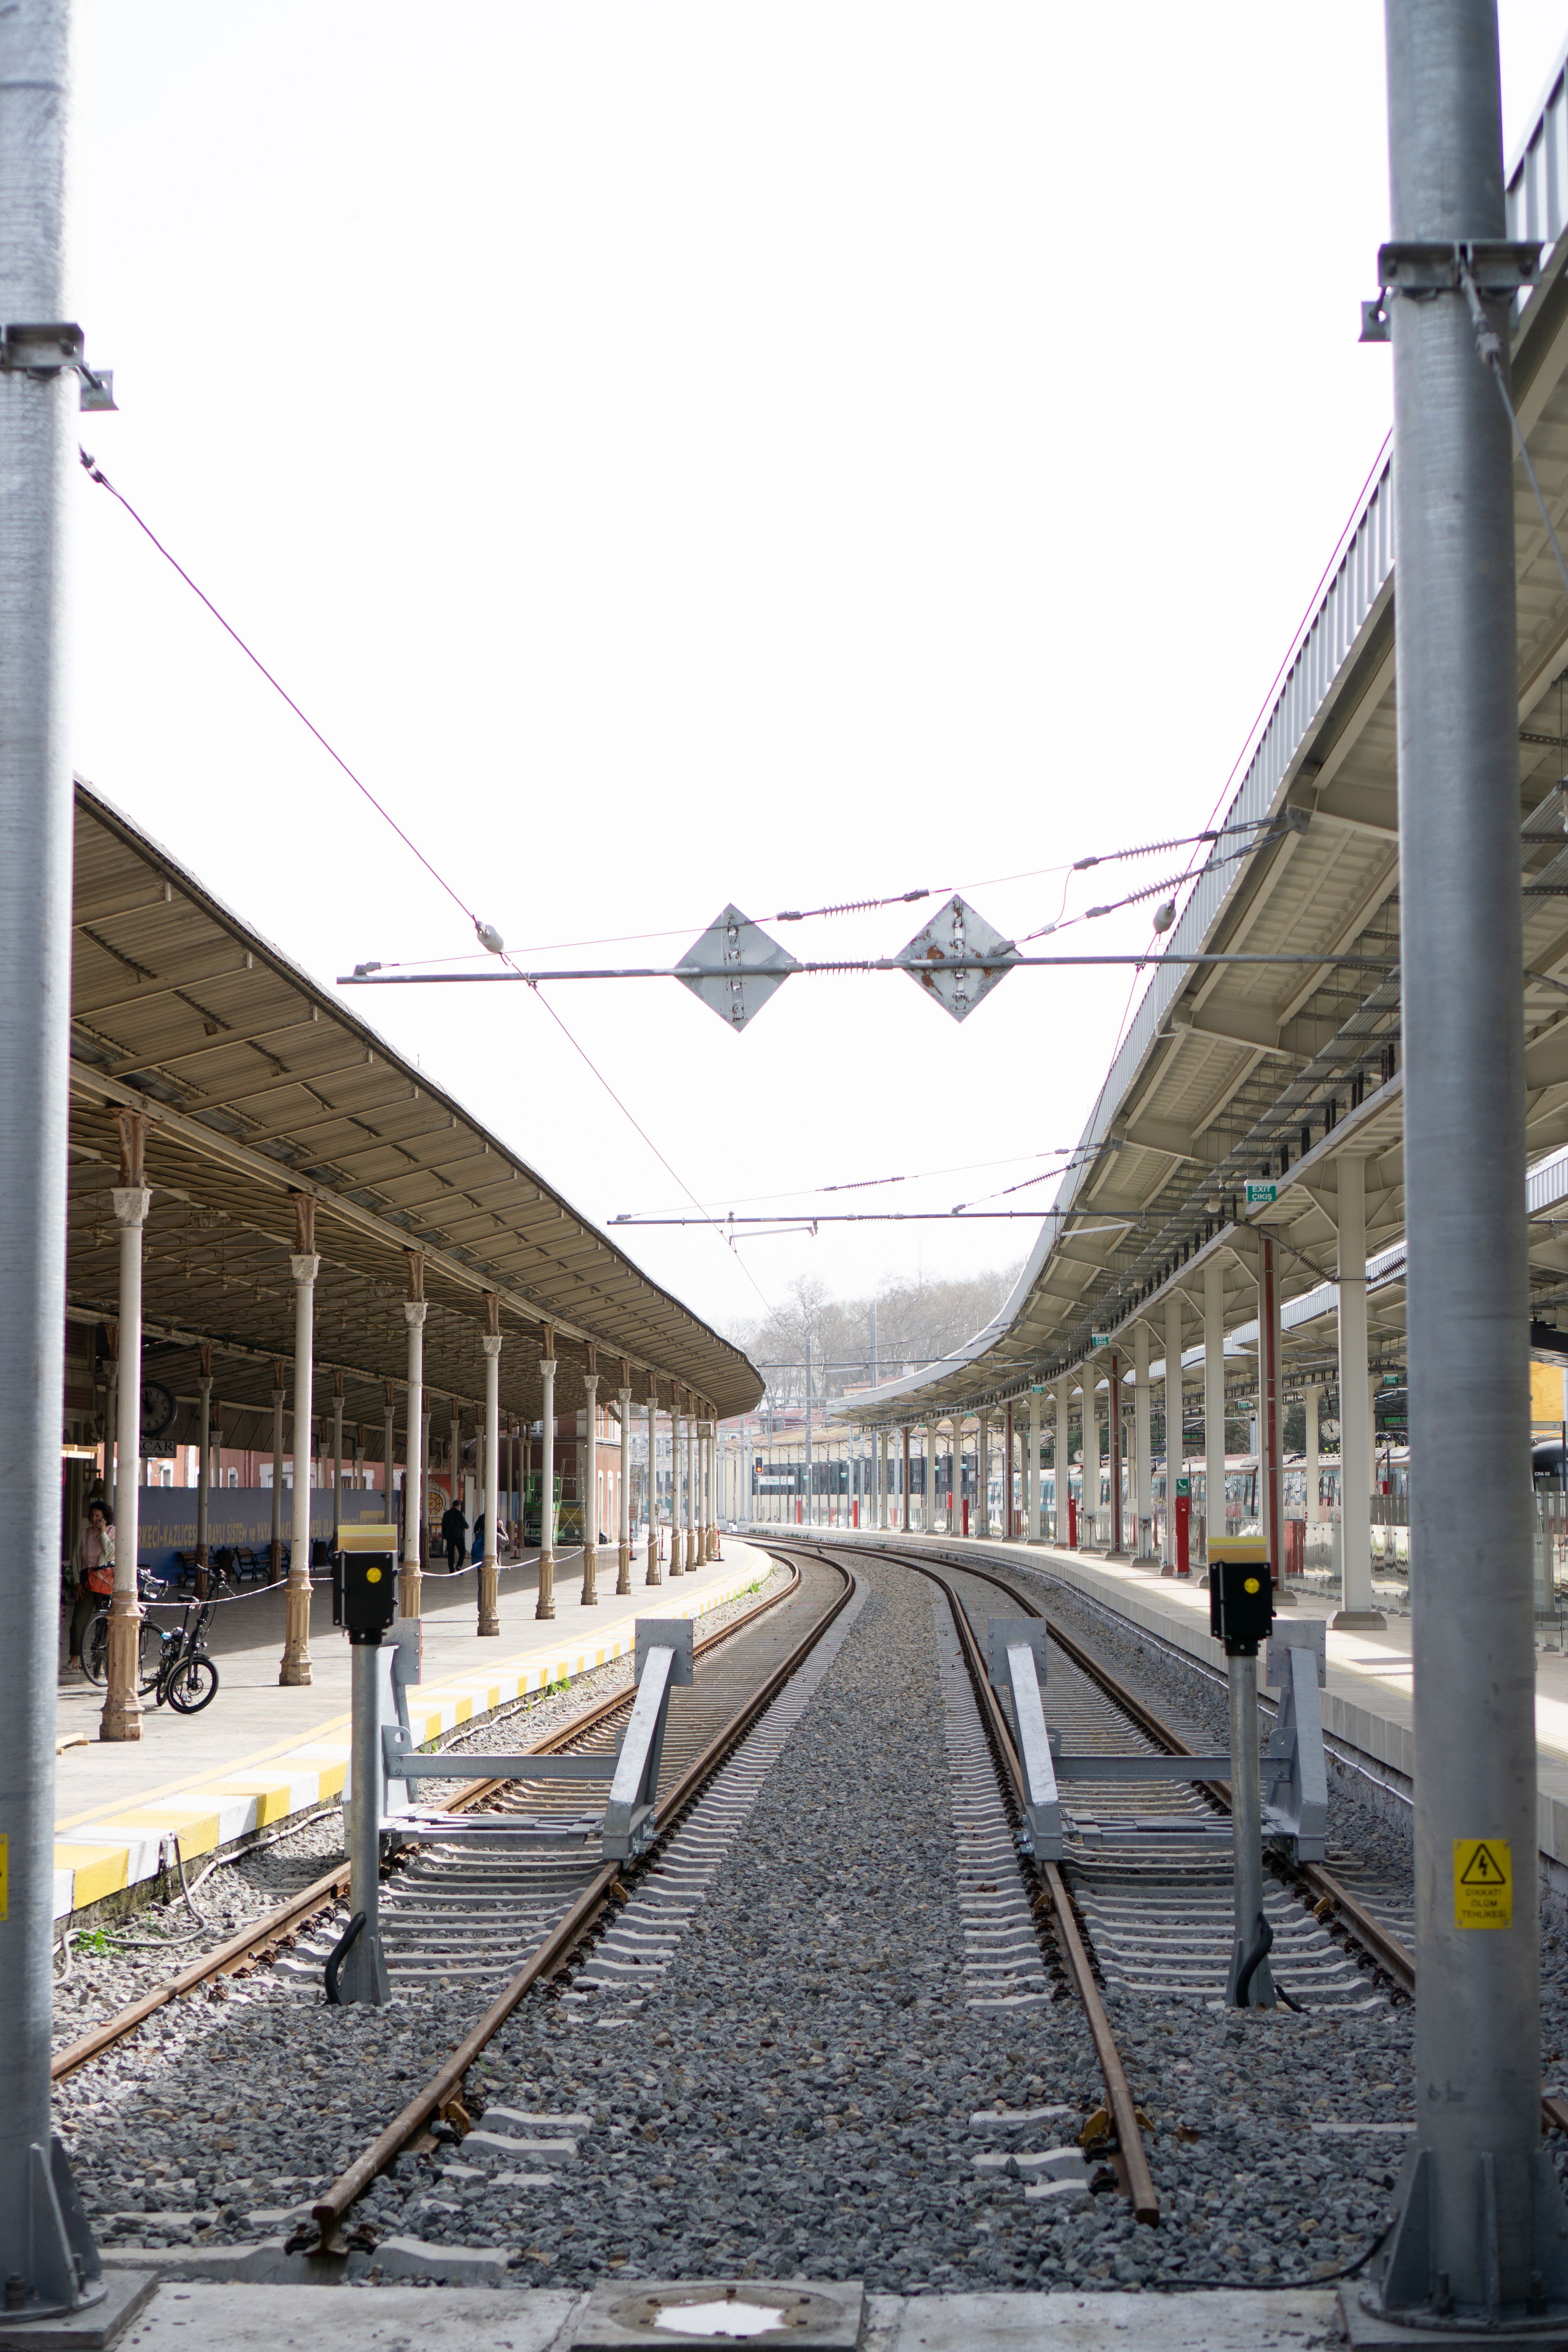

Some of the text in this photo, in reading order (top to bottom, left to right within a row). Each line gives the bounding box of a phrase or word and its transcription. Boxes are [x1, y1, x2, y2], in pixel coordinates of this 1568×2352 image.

[207, 1523, 225, 1544] RAYLI
[227, 1518, 247, 1544] SİSTEM
[249, 1527, 255, 1542] ve
[257, 1521, 271, 1542] YAYA
[1471, 1899, 1497, 1907] ÖLÜM
